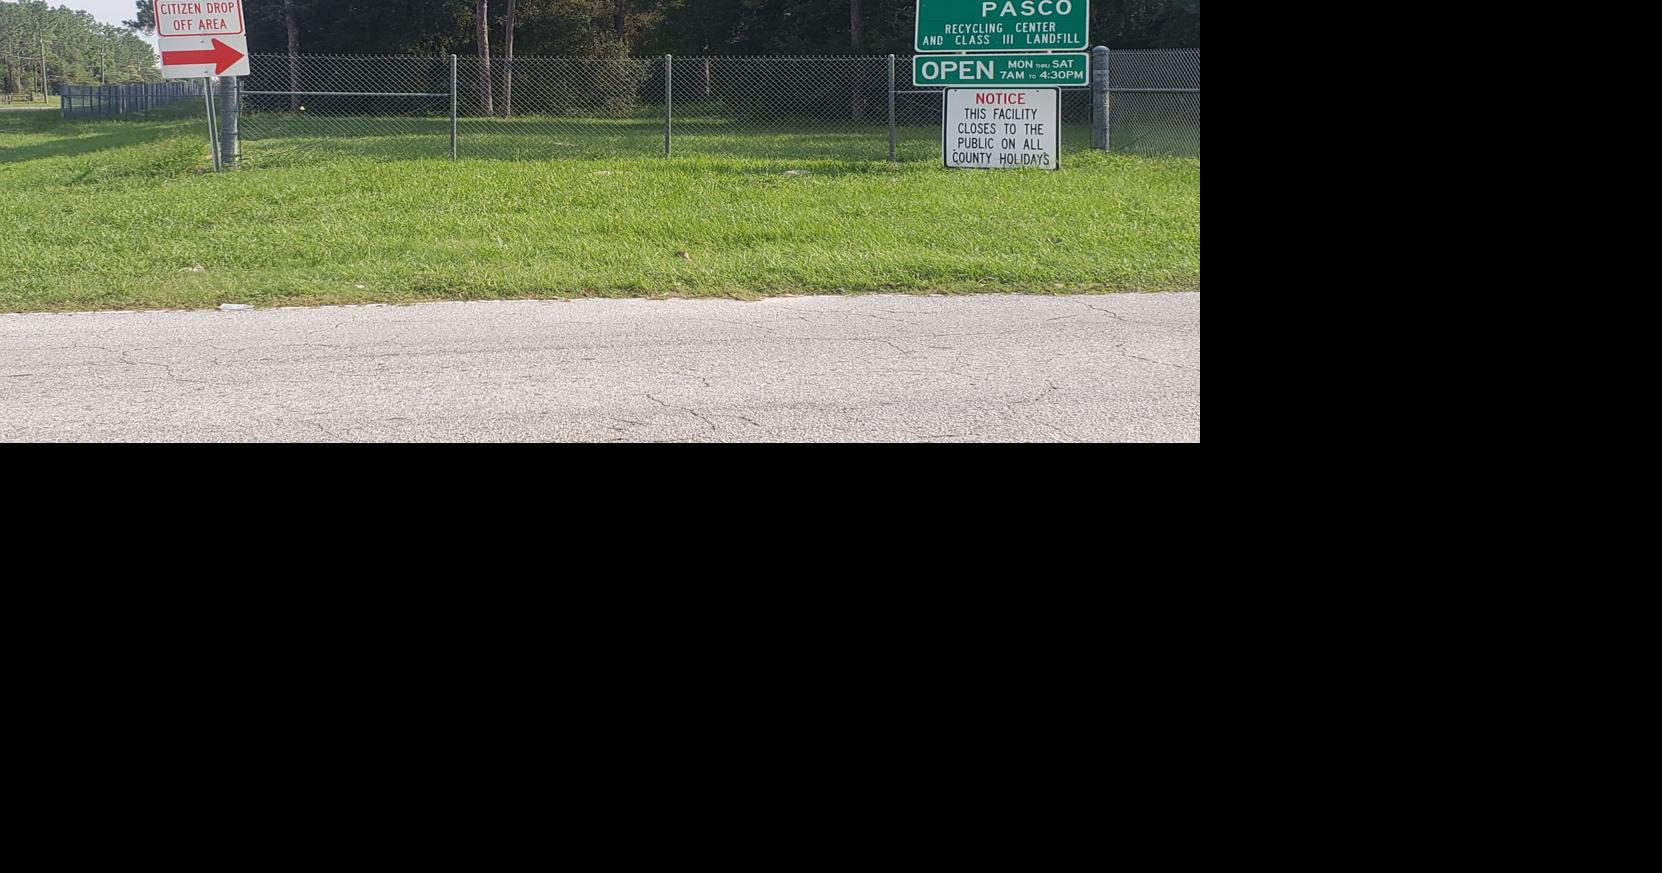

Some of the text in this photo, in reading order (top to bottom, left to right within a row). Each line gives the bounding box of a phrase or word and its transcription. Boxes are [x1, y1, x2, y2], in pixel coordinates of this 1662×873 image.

[160, 2, 234, 15] CITIZEN DROP
[982, 0, 1072, 17] PASCO
[173, 19, 227, 30] OFF AREA
[945, 22, 1056, 34] RECYCLING CENTER
[923, 33, 1080, 46] AND CLASS III LANDFILL
[921, 61, 994, 80] OPEN
[1008, 60, 1033, 69] MON
[1052, 60, 1074, 68] SAT
[1000, 71, 1025, 79] 7AM
[1039, 70, 1083, 79] 4:30PM
[975, 93, 1026, 105] NOTICE
[964, 108, 1038, 120] THIS FACILITY
[957, 122, 1044, 135] CLOSES TO THE
[957, 137, 1044, 151] PUBLIC ON ALL
[952, 151, 1050, 165] COUNTY HOLIDAYS
